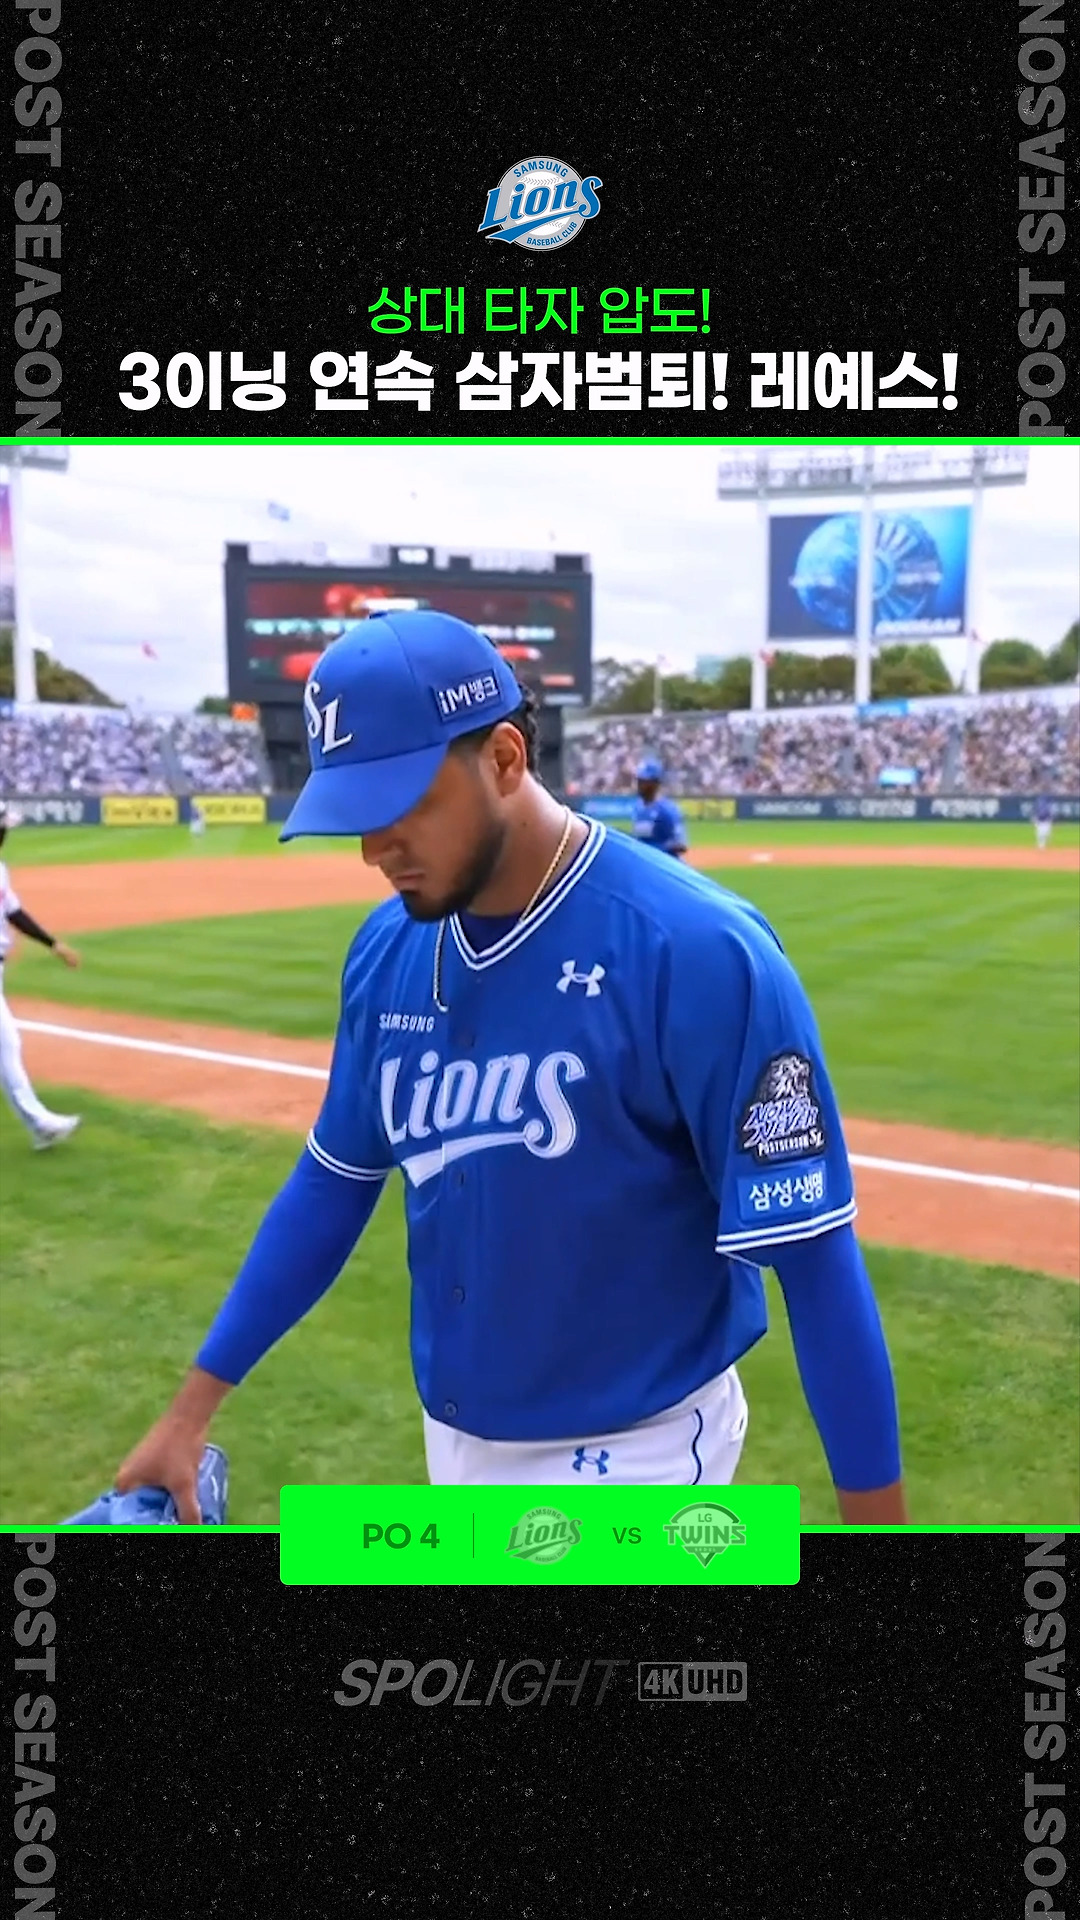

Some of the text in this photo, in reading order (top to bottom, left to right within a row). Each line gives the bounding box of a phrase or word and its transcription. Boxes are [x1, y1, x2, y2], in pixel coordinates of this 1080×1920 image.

[379, 1013, 436, 1033] SAMSUNG
[380, 1050, 586, 1187] Lions
[749, 1169, 824, 1212] 삼성생명
